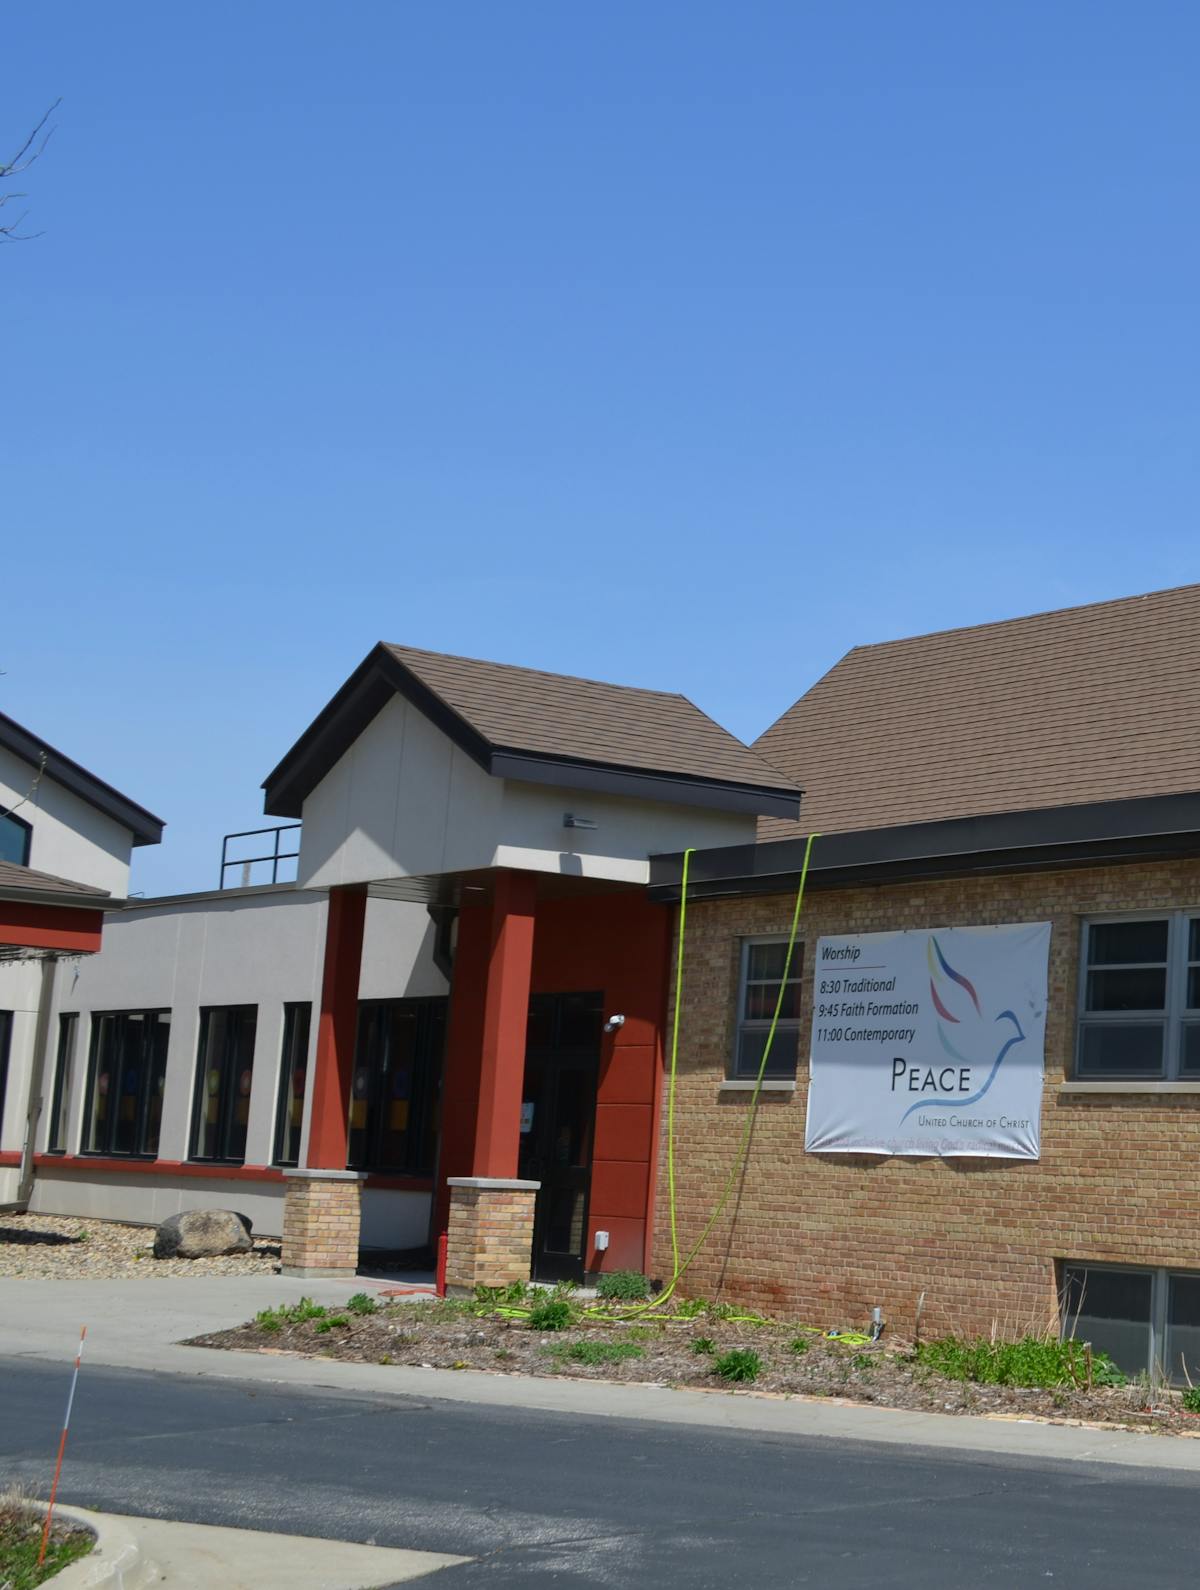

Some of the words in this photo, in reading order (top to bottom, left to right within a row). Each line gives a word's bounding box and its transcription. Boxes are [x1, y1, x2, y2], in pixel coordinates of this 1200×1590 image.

[822, 946, 861, 963] Worship
[820, 980, 841, 994] 8:30
[843, 976, 896, 993] Traditional
[818, 1003, 839, 1017] 9:45
[841, 1002, 865, 1017] Faith
[866, 1001, 919, 1016] Formation
[817, 1028, 842, 1042] 11:00
[844, 1027, 915, 1044] Contemporary
[891, 1057, 971, 1092] PEACE
[918, 1115, 947, 1127] UNITED
[949, 1115, 983, 1128] CHURCH
[999, 1116, 1029, 1129] CHRIST
